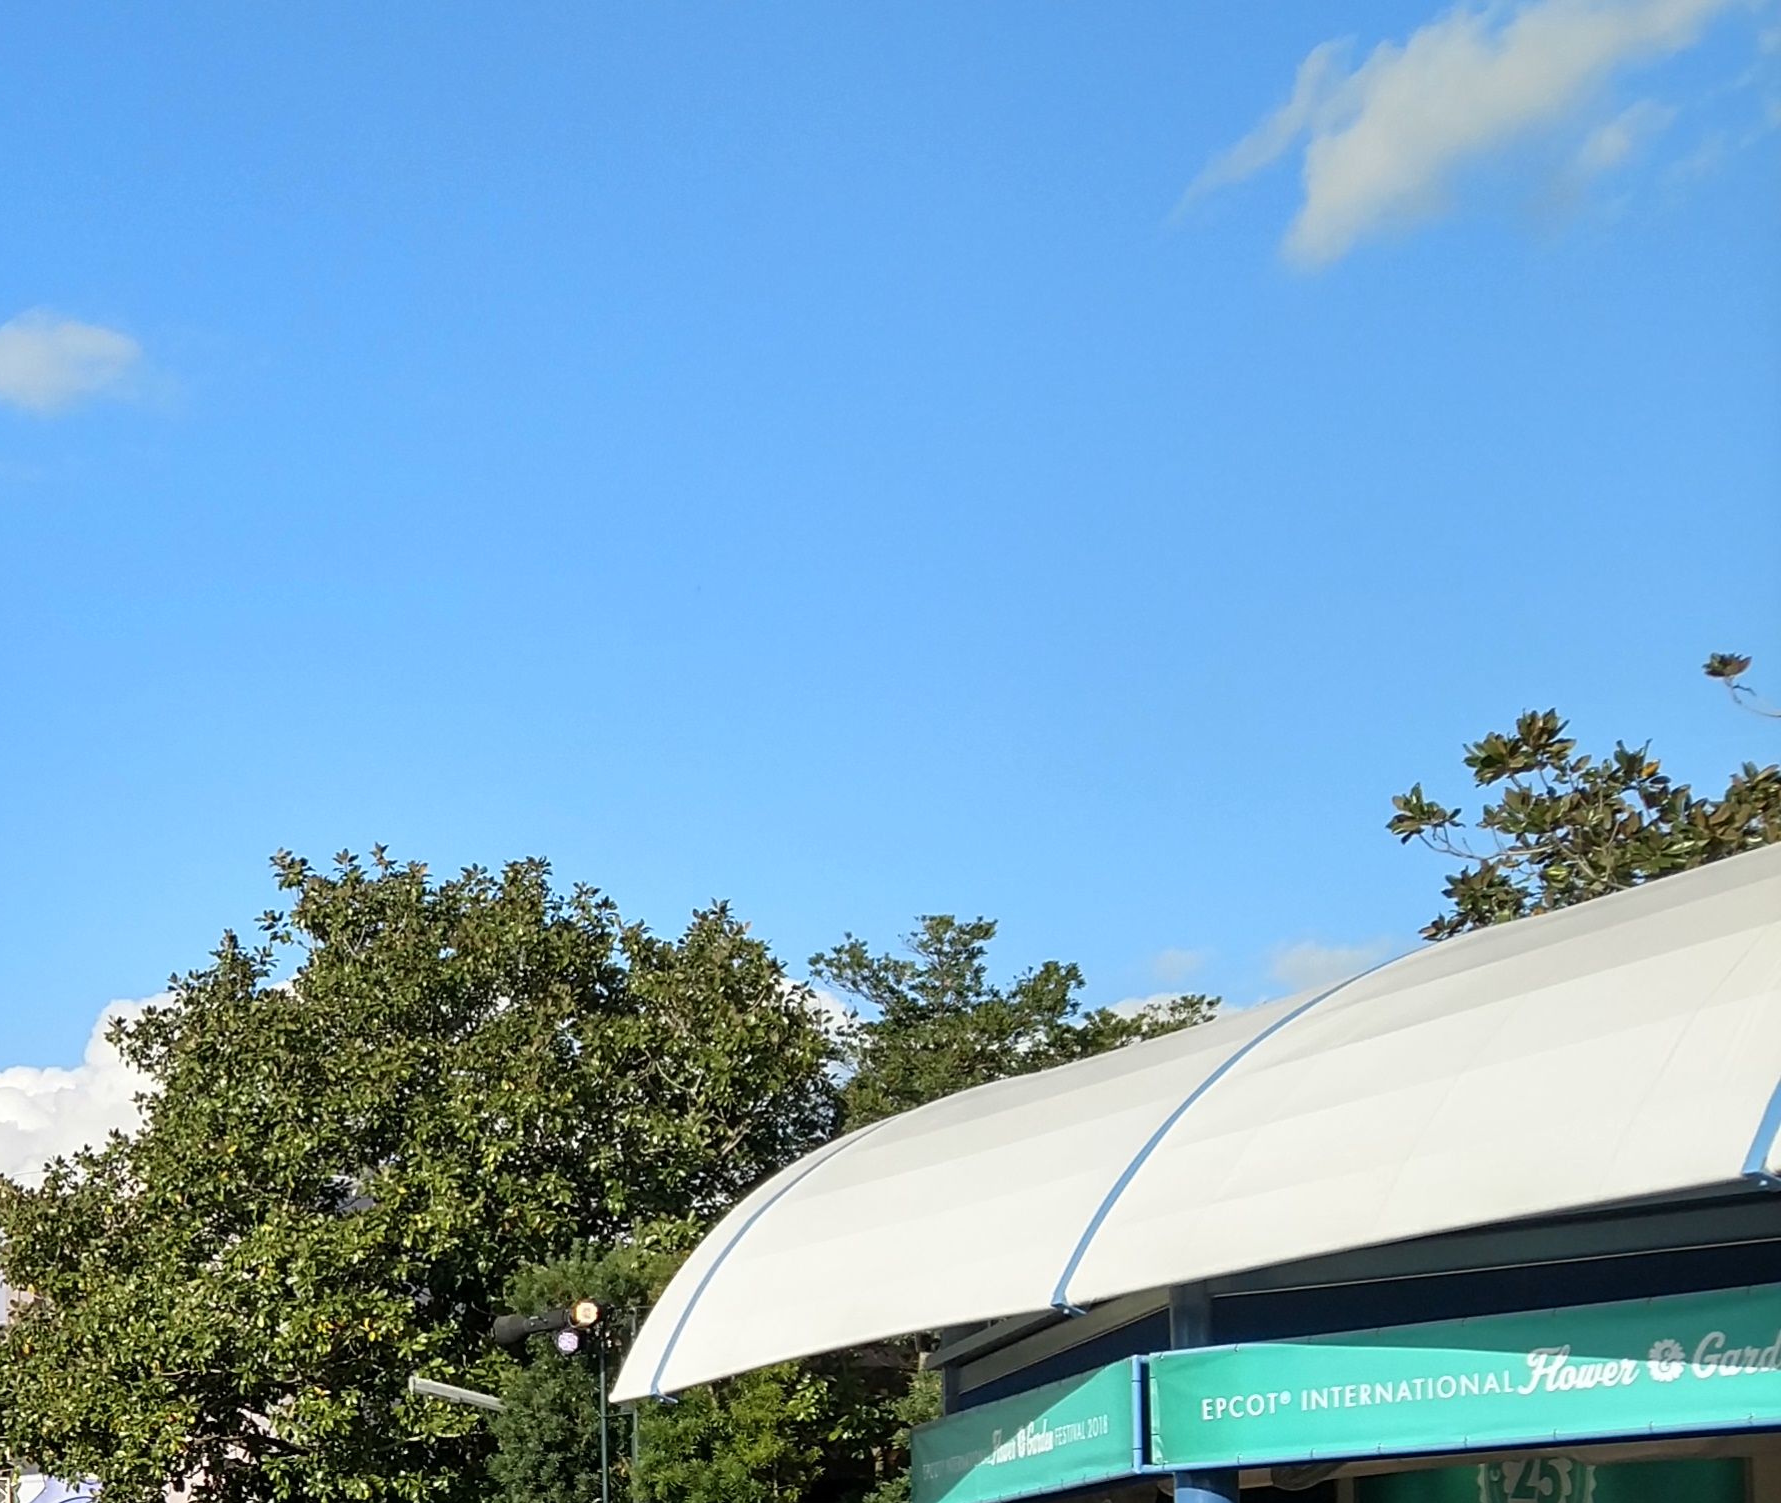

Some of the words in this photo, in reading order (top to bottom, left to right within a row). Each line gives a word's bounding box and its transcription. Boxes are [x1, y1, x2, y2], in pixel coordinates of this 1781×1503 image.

[1301, 1371, 1515, 1411] INTERNATIONAL
[1518, 1344, 1640, 1395] Flower
[1054, 1420, 1086, 1447] FESTIVAL
